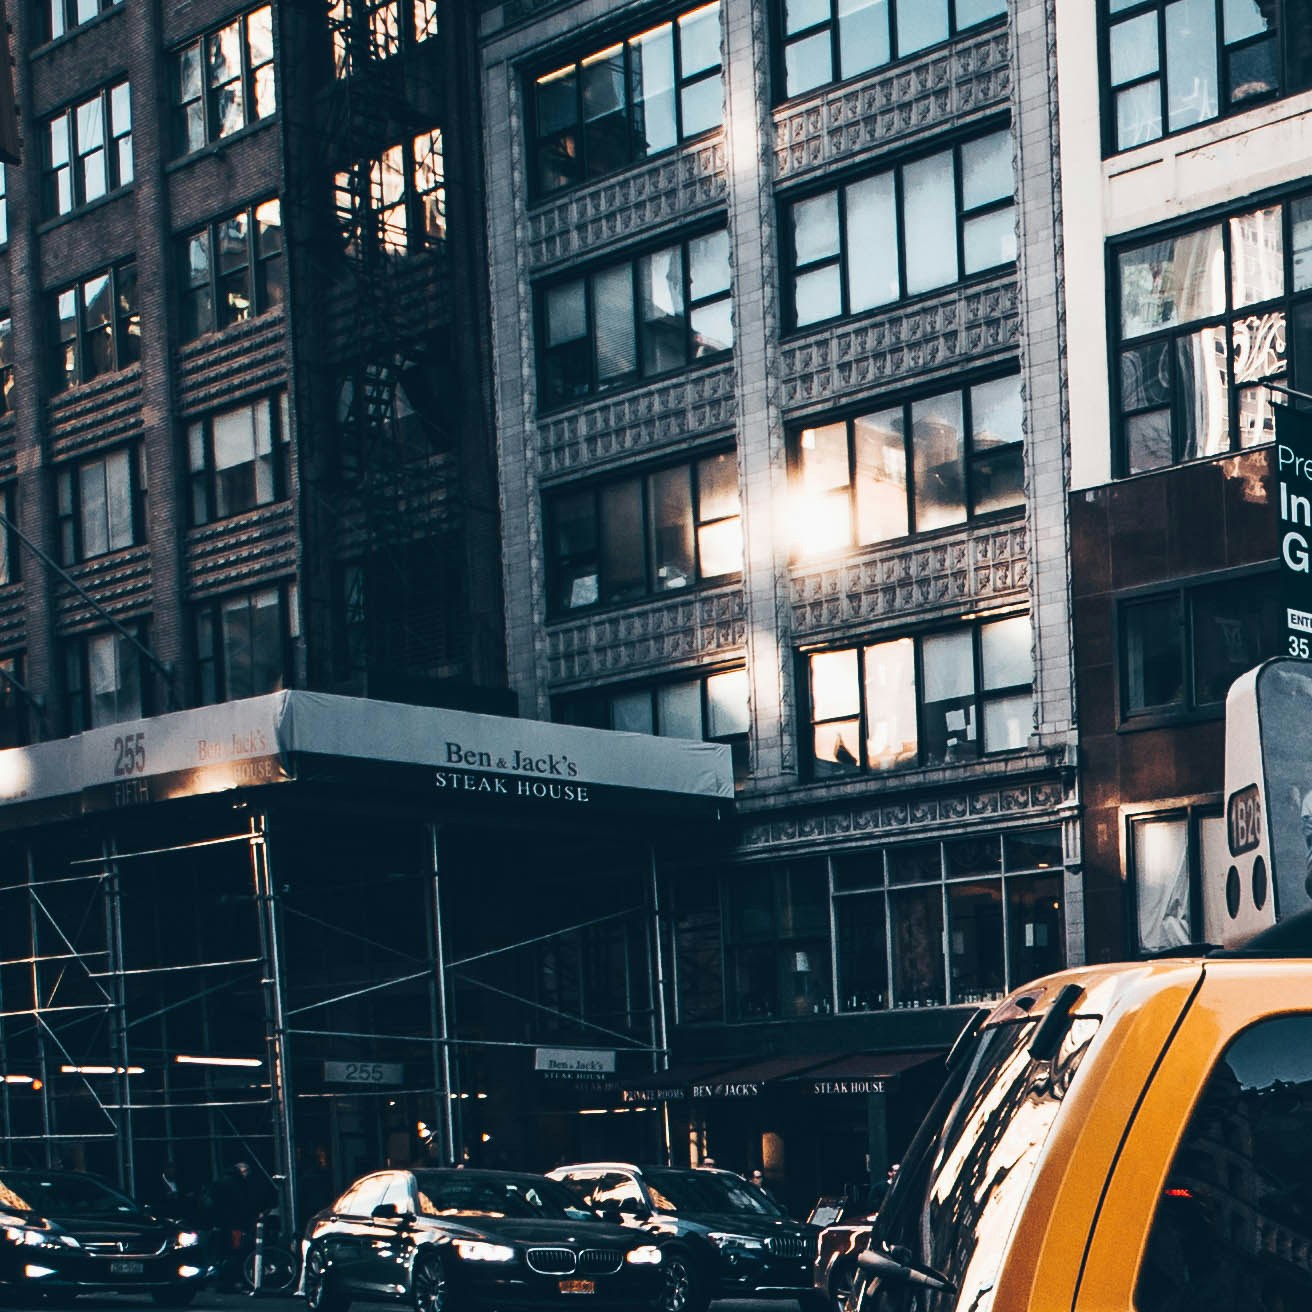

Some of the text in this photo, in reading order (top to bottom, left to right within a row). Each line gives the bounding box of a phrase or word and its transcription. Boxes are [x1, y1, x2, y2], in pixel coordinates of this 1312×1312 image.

[1288, 635, 1310, 658] 35
[113, 732, 146, 776] 255
[445, 742, 578, 777] Ben & Jack's
[436, 772, 590, 802] STEAK HOUSE
[1231, 797, 1261, 849] 1B26
[345, 1064, 383, 1080] 255
[693, 1085, 712, 1097] BEN
[724, 1084, 758, 1097] JACK'S
[814, 1081, 886, 1095] STEAK HOUSE
